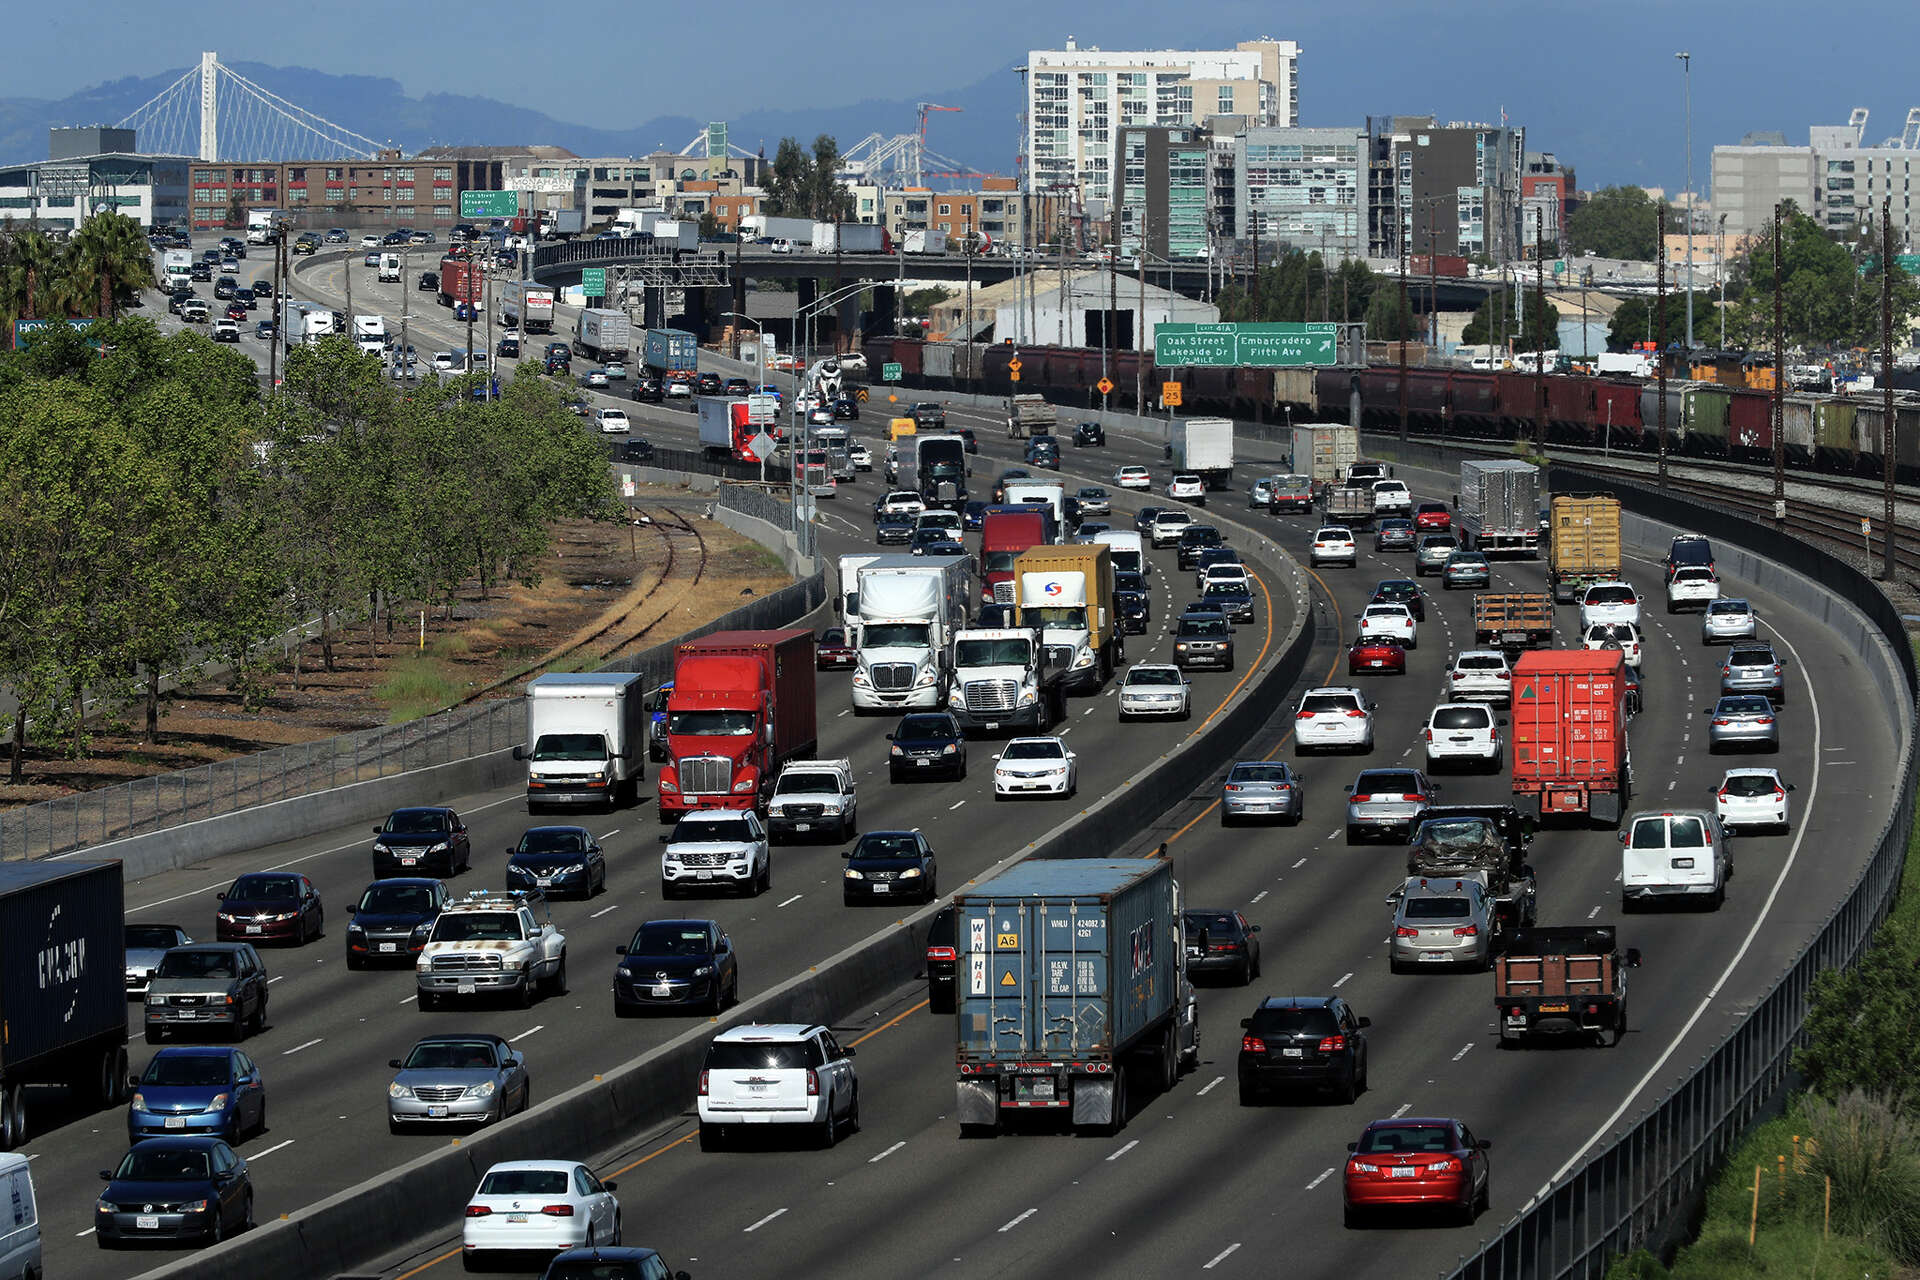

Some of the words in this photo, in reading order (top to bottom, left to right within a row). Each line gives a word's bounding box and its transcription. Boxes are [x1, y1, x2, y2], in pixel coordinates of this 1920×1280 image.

[1167, 337, 1186, 345] Oak
[1190, 337, 1225, 345] Street
[1241, 336, 1312, 345] Embarcadero
[1163, 348, 1211, 356] Lakeside
[1215, 348, 1228, 356] Dr
[1250, 347, 1278, 356] Fifth
[1282, 347, 1302, 356] Ave
[1193, 356, 1214, 364] MILE
[1165, 392, 1179, 400] 25
[1050, 919, 1068, 928] WHLU
[972, 923, 984, 952] WAN
[1000, 936, 1016, 946] A6
[974, 960, 983, 989] HAI
